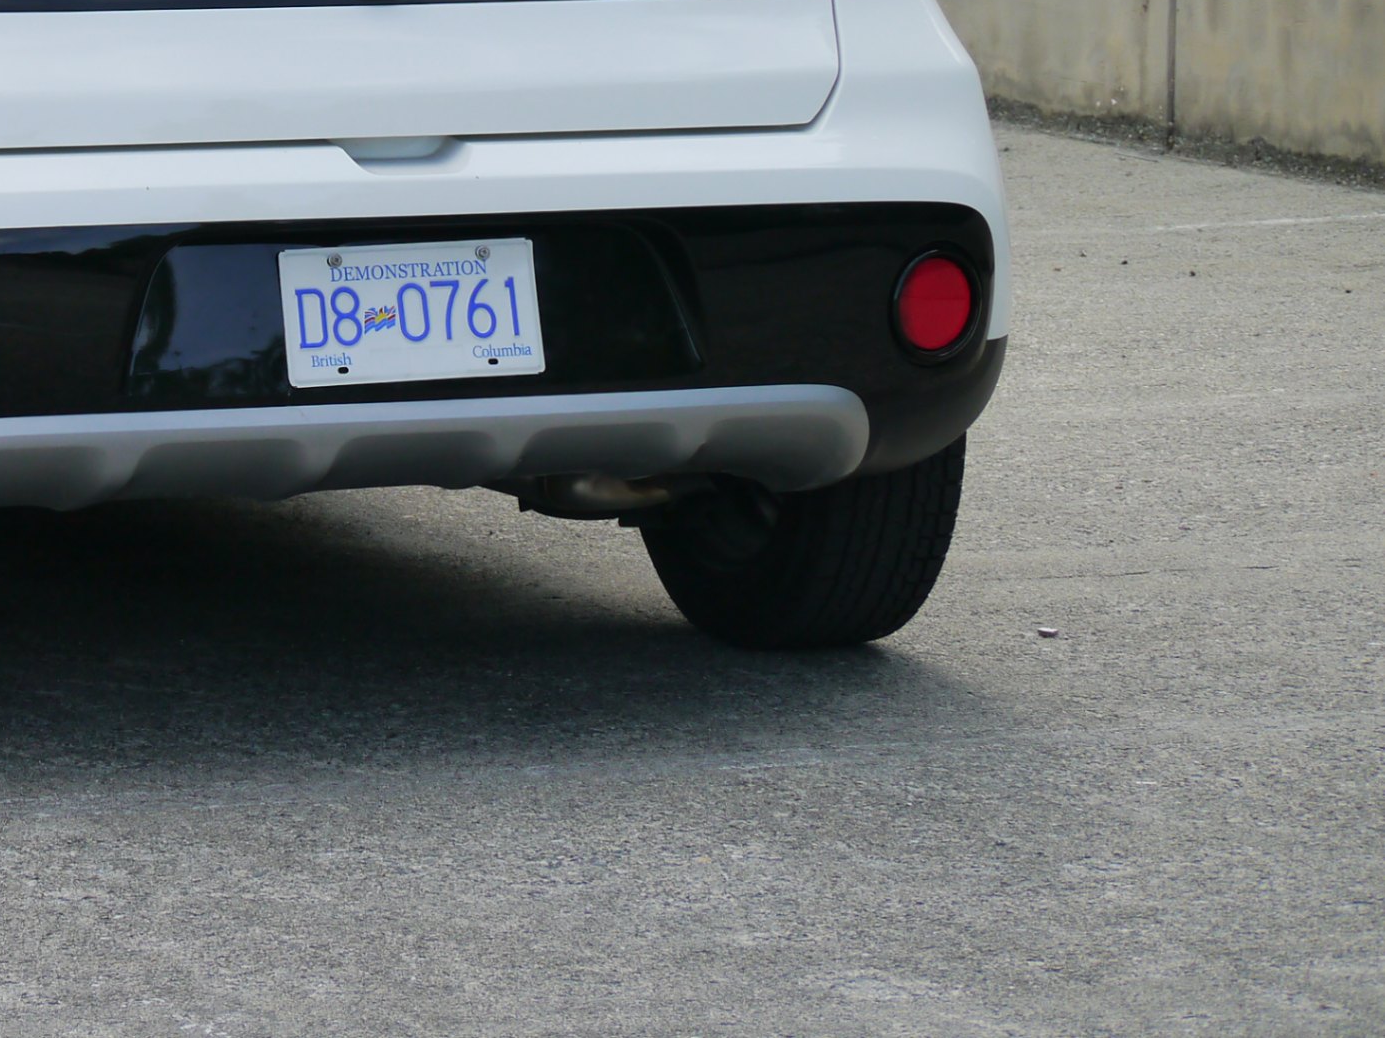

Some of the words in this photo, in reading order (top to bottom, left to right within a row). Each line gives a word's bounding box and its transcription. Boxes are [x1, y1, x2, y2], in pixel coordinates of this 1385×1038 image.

[330, 259, 488, 282] DEMONSTRATION
[311, 352, 352, 367] British
[472, 343, 532, 359] Columbia
